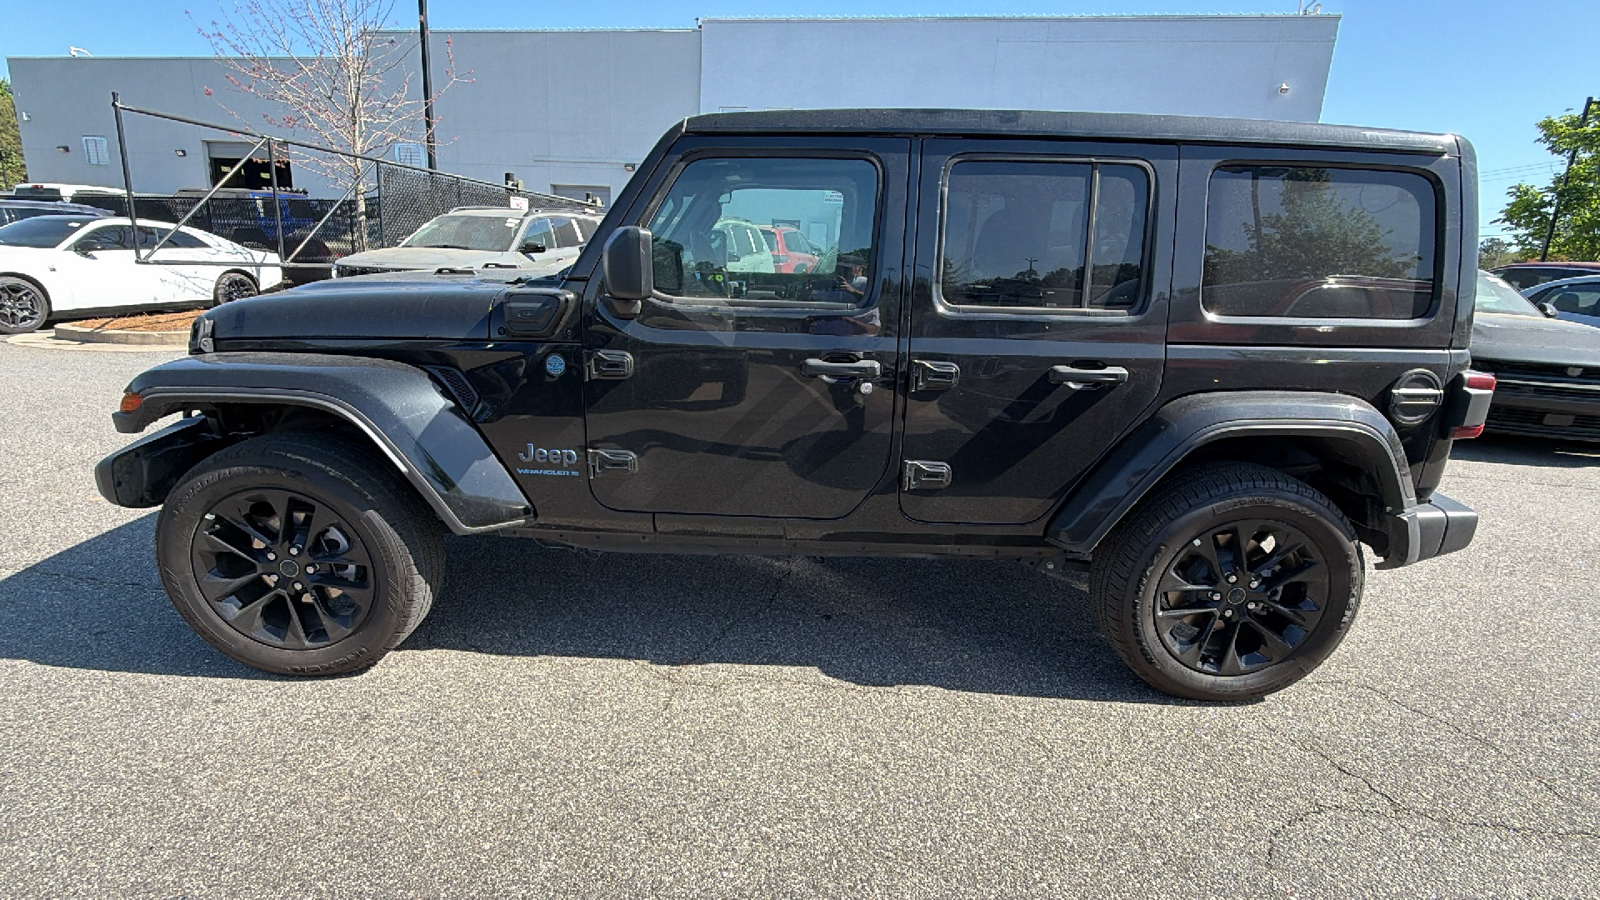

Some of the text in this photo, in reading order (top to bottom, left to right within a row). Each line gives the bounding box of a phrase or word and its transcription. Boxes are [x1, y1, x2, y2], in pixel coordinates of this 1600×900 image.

[518, 443, 577, 467] Jeep
[516, 468, 570, 477] WRANGLER
[1341, 560, 1357, 623] NEXEN
